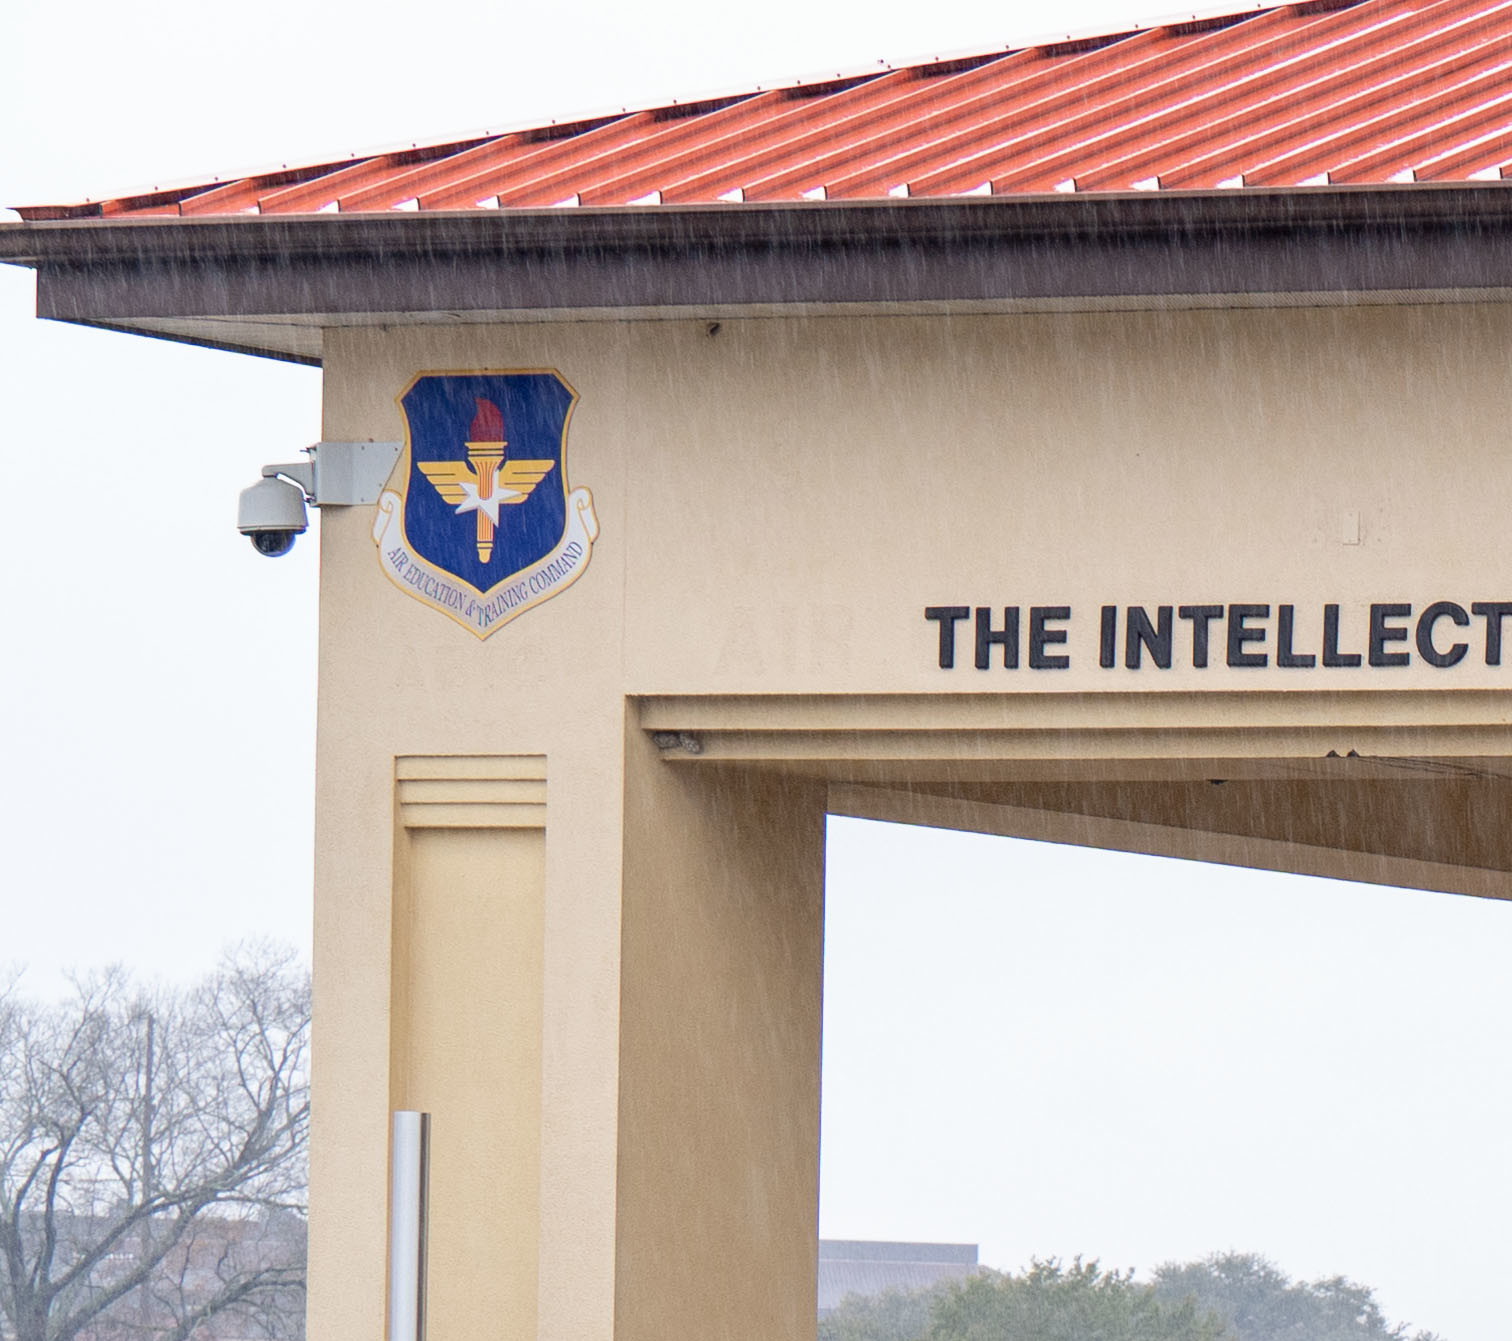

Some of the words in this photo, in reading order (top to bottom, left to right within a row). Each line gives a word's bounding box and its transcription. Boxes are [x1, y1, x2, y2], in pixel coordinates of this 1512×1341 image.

[387, 547, 408, 573] AIR
[403, 566, 467, 611] EDUCATION
[465, 599, 476, 617] &
[476, 584, 530, 628] TRAINING
[529, 541, 584, 594] COMMAND
[924, 606, 1071, 671] THE
